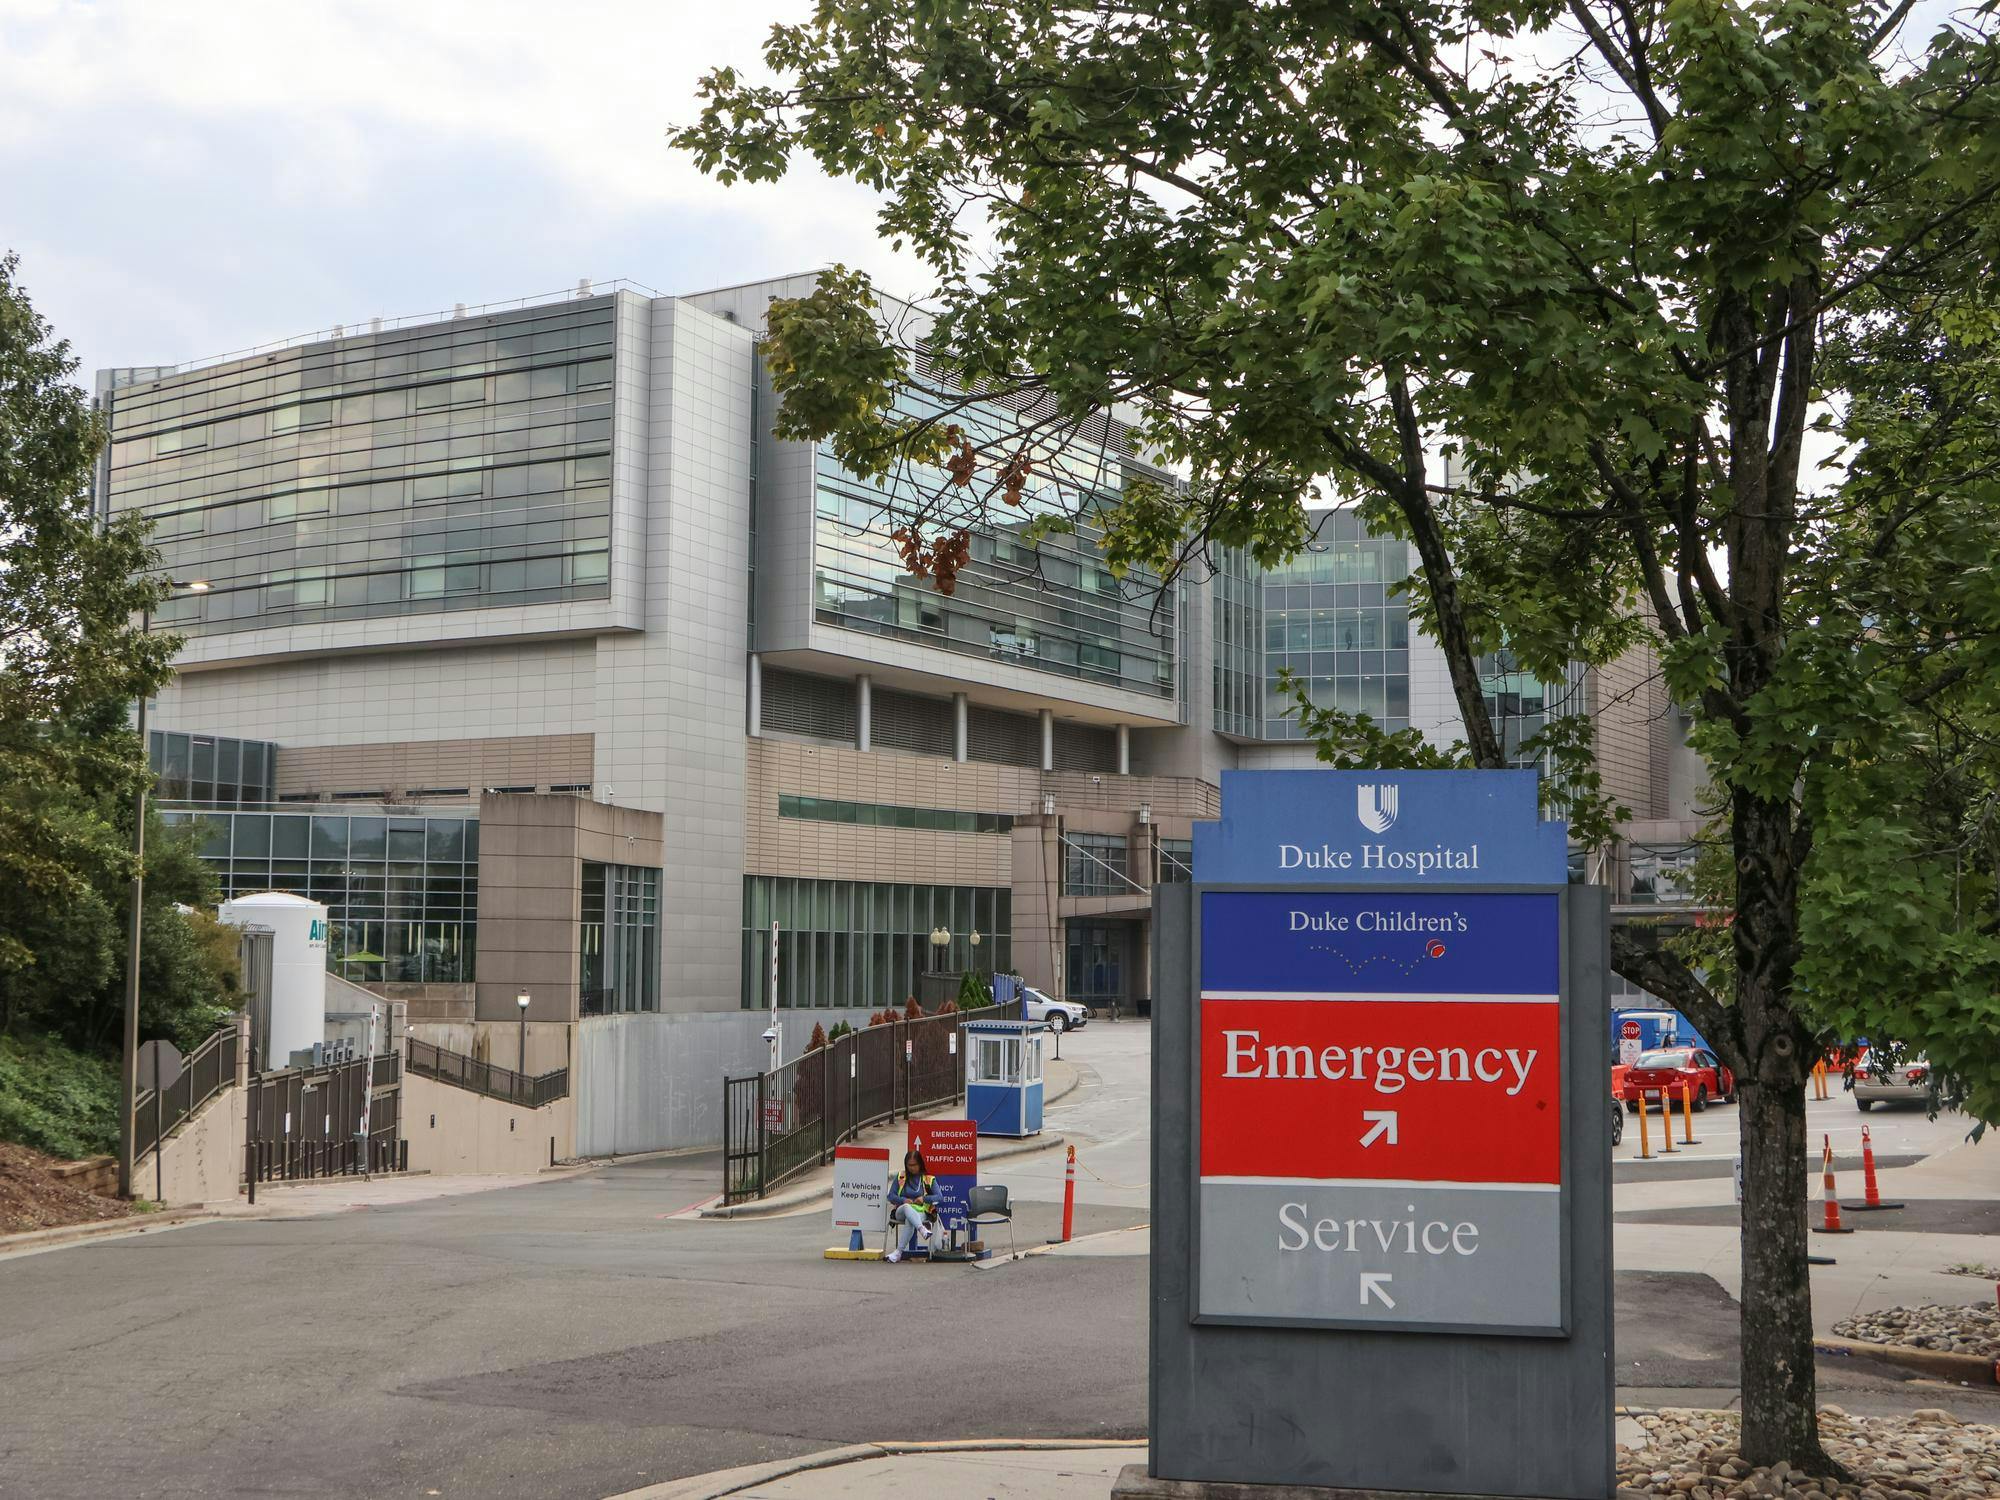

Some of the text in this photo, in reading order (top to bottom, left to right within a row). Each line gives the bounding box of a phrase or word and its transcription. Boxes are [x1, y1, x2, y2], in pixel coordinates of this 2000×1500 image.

[1278, 844, 1480, 875] Duke Hospital
[1289, 911, 1468, 932] Duke Children's
[1623, 1026, 1640, 1035] STOP
[1221, 1030, 1538, 1096] Emergency
[840, 1191, 880, 1201] Keep Right
[851, 1183, 881, 1191] Vehicles
[1278, 1202, 1480, 1256] Service
